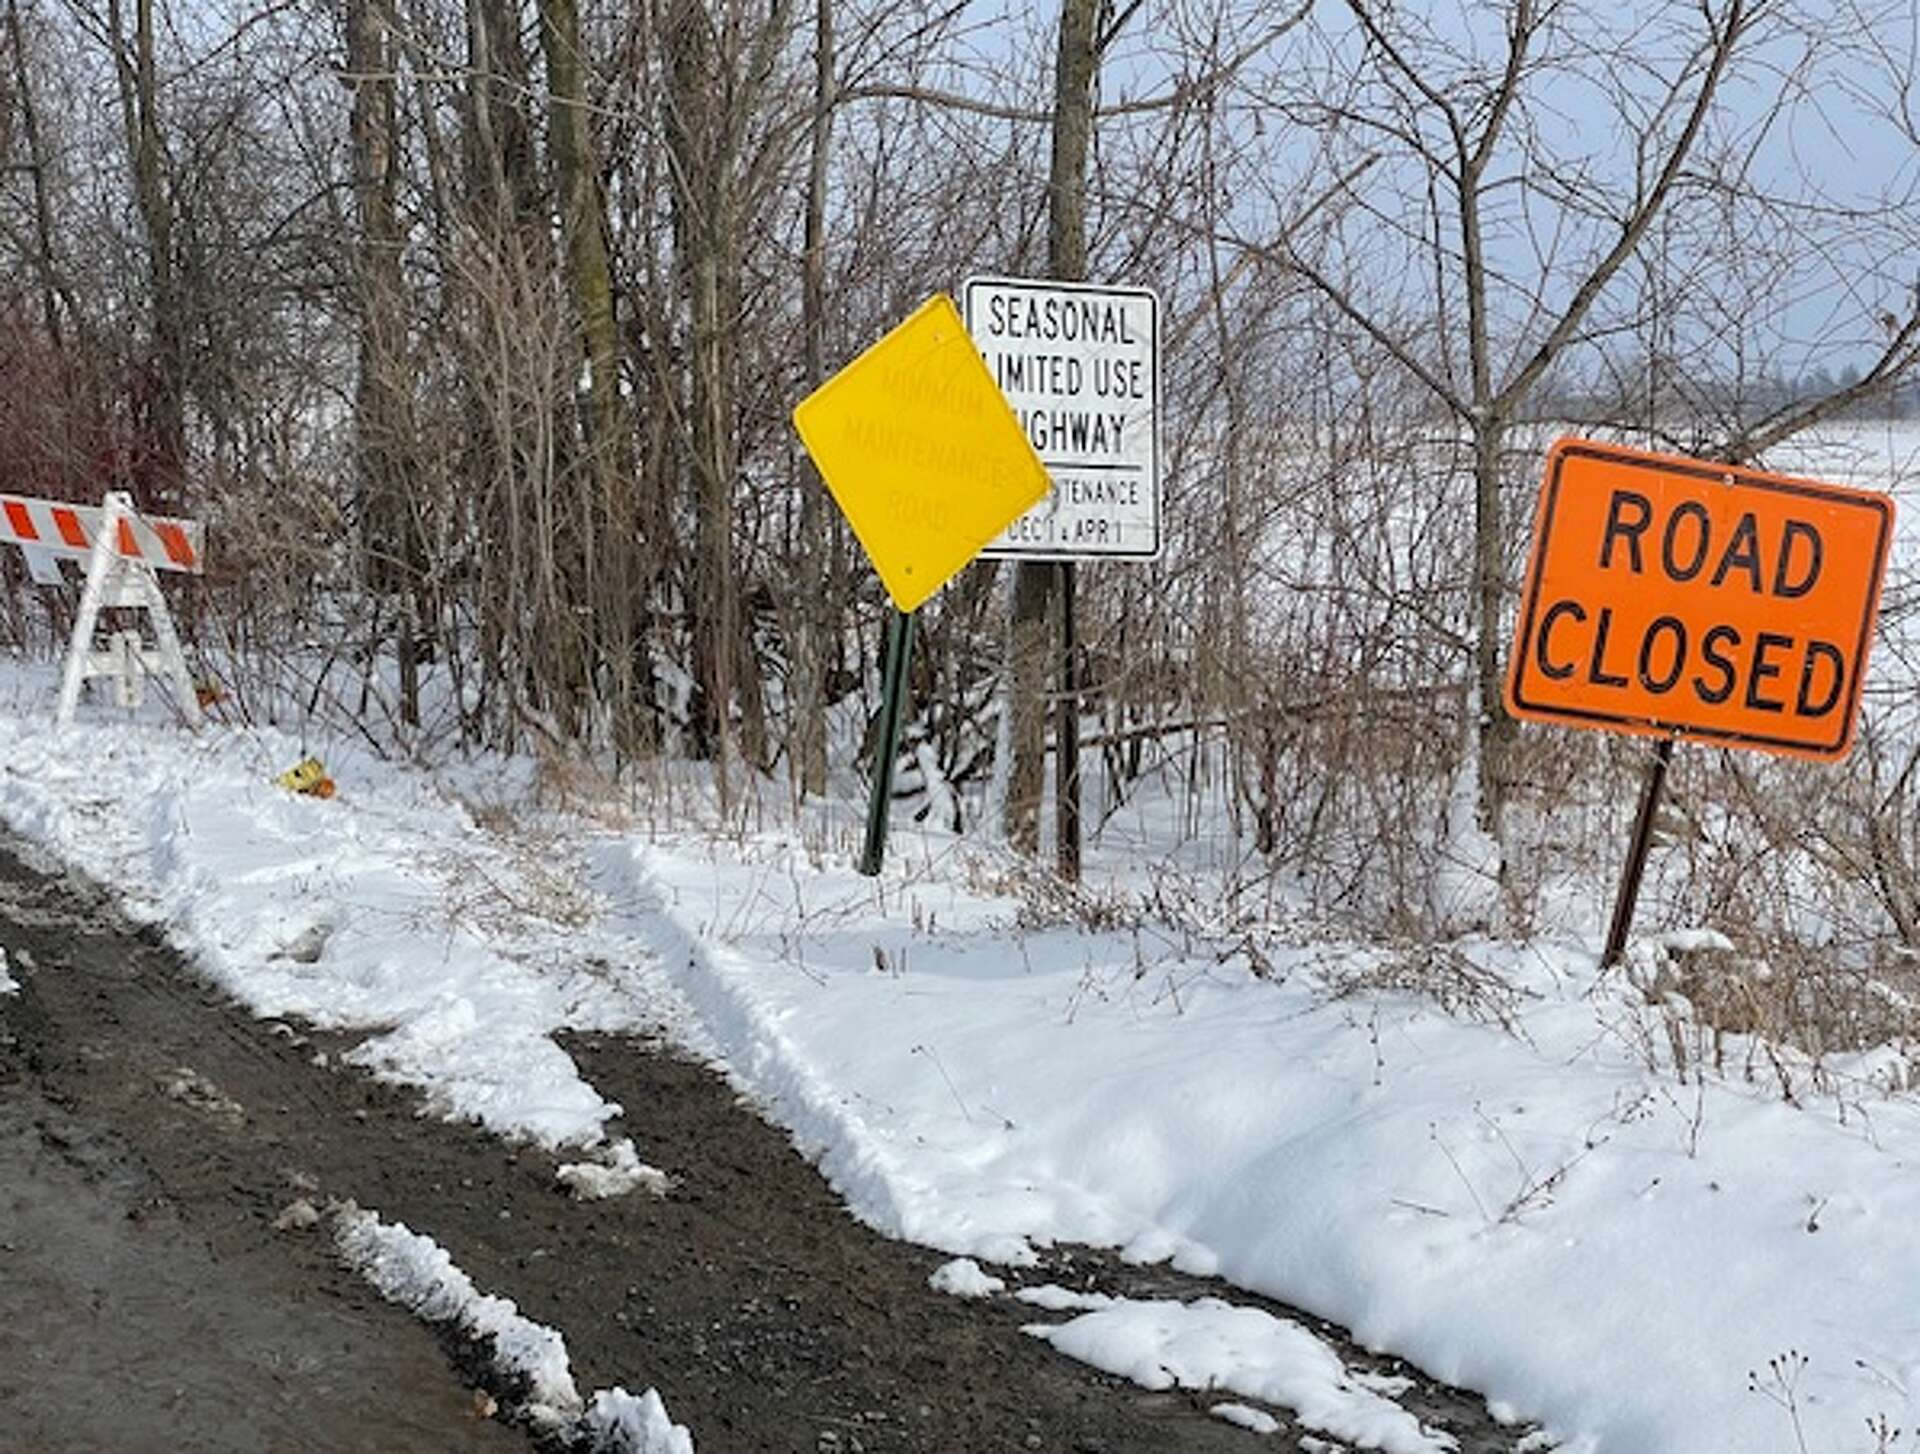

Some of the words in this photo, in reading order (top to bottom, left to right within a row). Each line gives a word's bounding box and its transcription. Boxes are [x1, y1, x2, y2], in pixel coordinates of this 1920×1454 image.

[988, 294, 1134, 344] SEASONAL
[982, 352, 1083, 396] IMITED
[1094, 358, 1144, 399] USE
[842, 413, 1008, 488] MAINTENANCE
[1012, 409, 1125, 454] IGHWAY
[888, 490, 949, 533] ROAD
[1058, 478, 1138, 505] TENANCE
[1072, 518, 1109, 543] APR
[1599, 490, 1824, 599] ROAD
[1535, 600, 1845, 719] CLOSED
